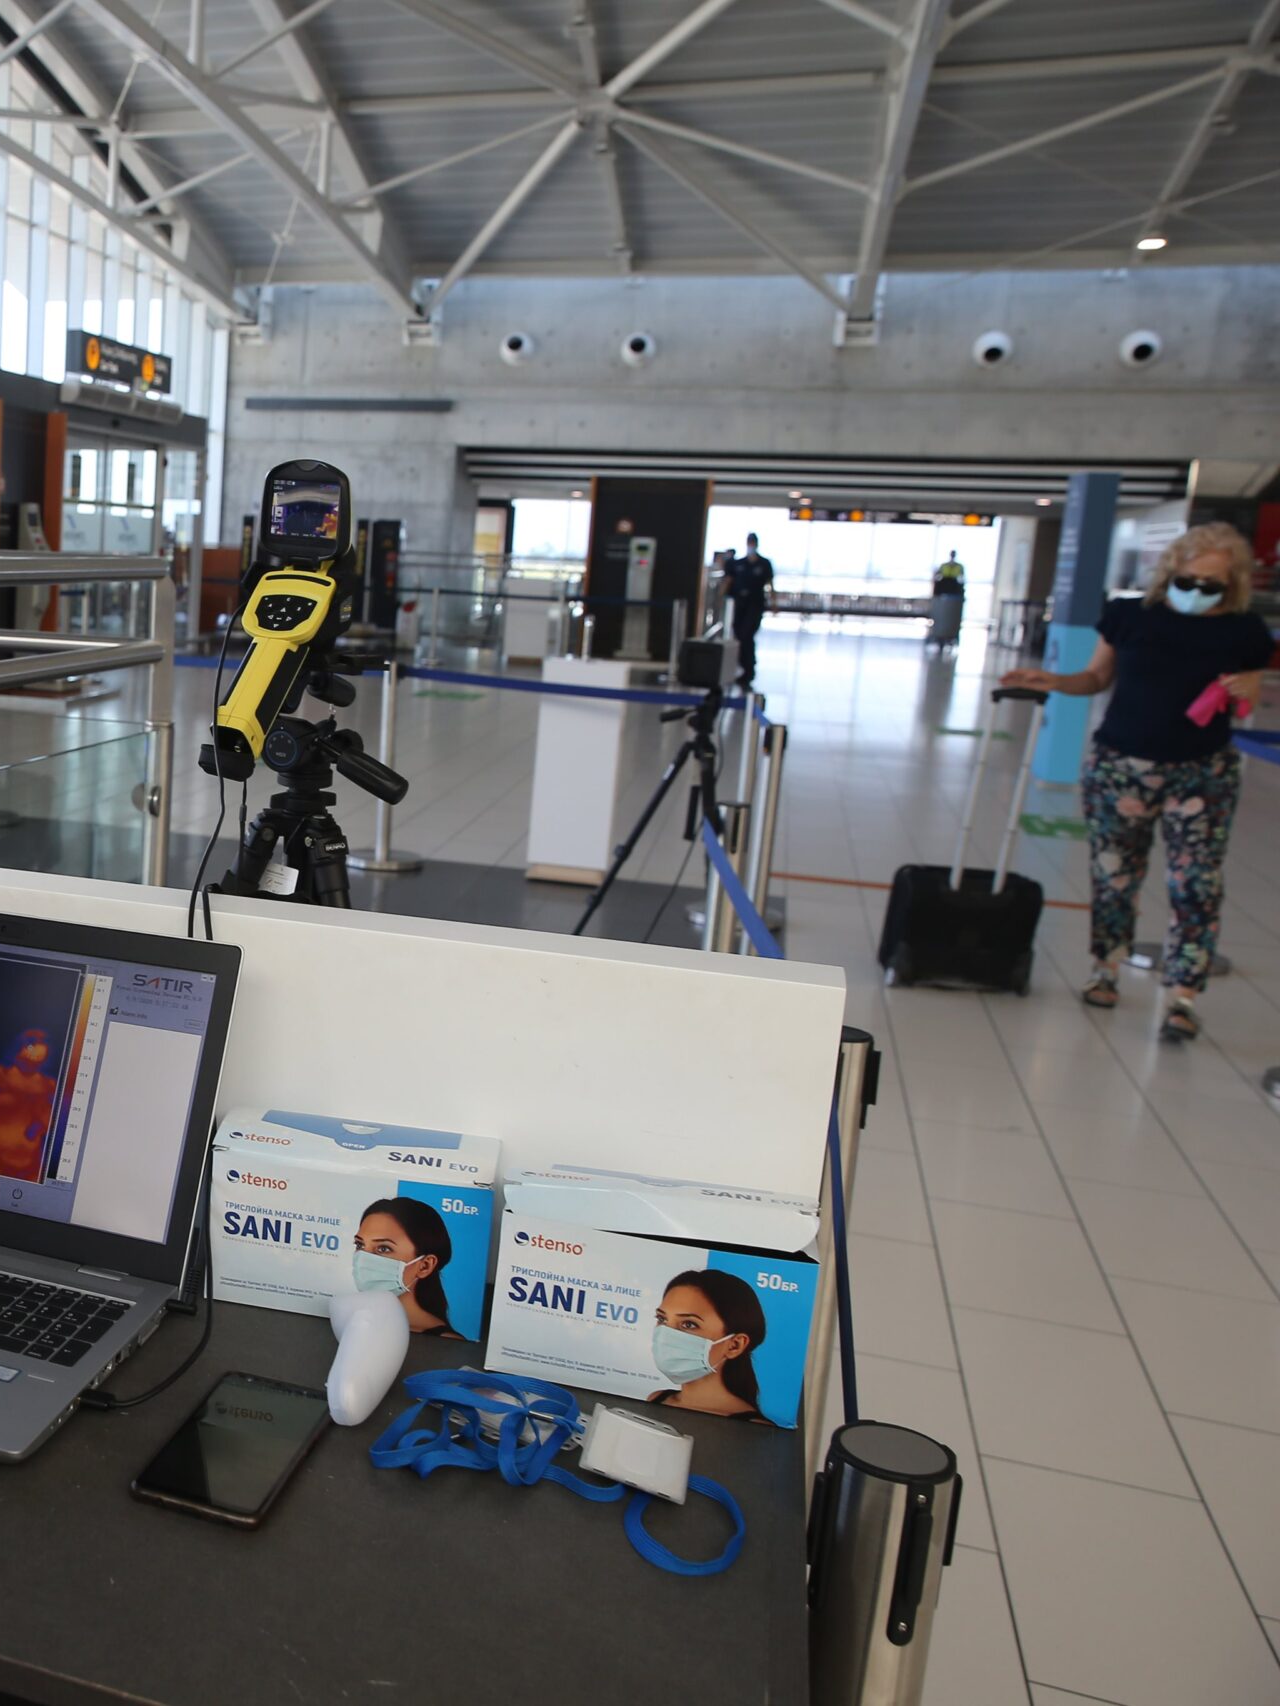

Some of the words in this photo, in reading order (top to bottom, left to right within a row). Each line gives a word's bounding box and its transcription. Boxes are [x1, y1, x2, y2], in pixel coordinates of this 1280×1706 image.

[133, 974, 193, 994] SATIR
[244, 1132, 291, 1146] stenso
[342, 1142, 366, 1150] OPEN
[388, 1151, 442, 1168] SANI
[448, 1163, 479, 1174] EVO
[241, 1170, 288, 1191] stenso
[701, 1188, 762, 1202] SANI
[771, 1199, 805, 1208] EVO
[225, 1201, 272, 1217] ТРИСЛОЙНА
[272, 1209, 304, 1221] МАСКА
[305, 1213, 316, 1223] ЗА
[317, 1216, 341, 1227] ЛИЦЕ
[223, 1211, 292, 1244] SANI
[301, 1231, 340, 1251] EVO
[531, 1234, 583, 1256] stenso
[511, 1265, 565, 1283] ТРИСЛОЙНА
[568, 1276, 600, 1291] МАСКА
[601, 1281, 614, 1292] ЗА
[615, 1285, 641, 1298] ЛИЦЕ
[508, 1276, 586, 1315] SANI
[596, 1301, 639, 1324] EVO
